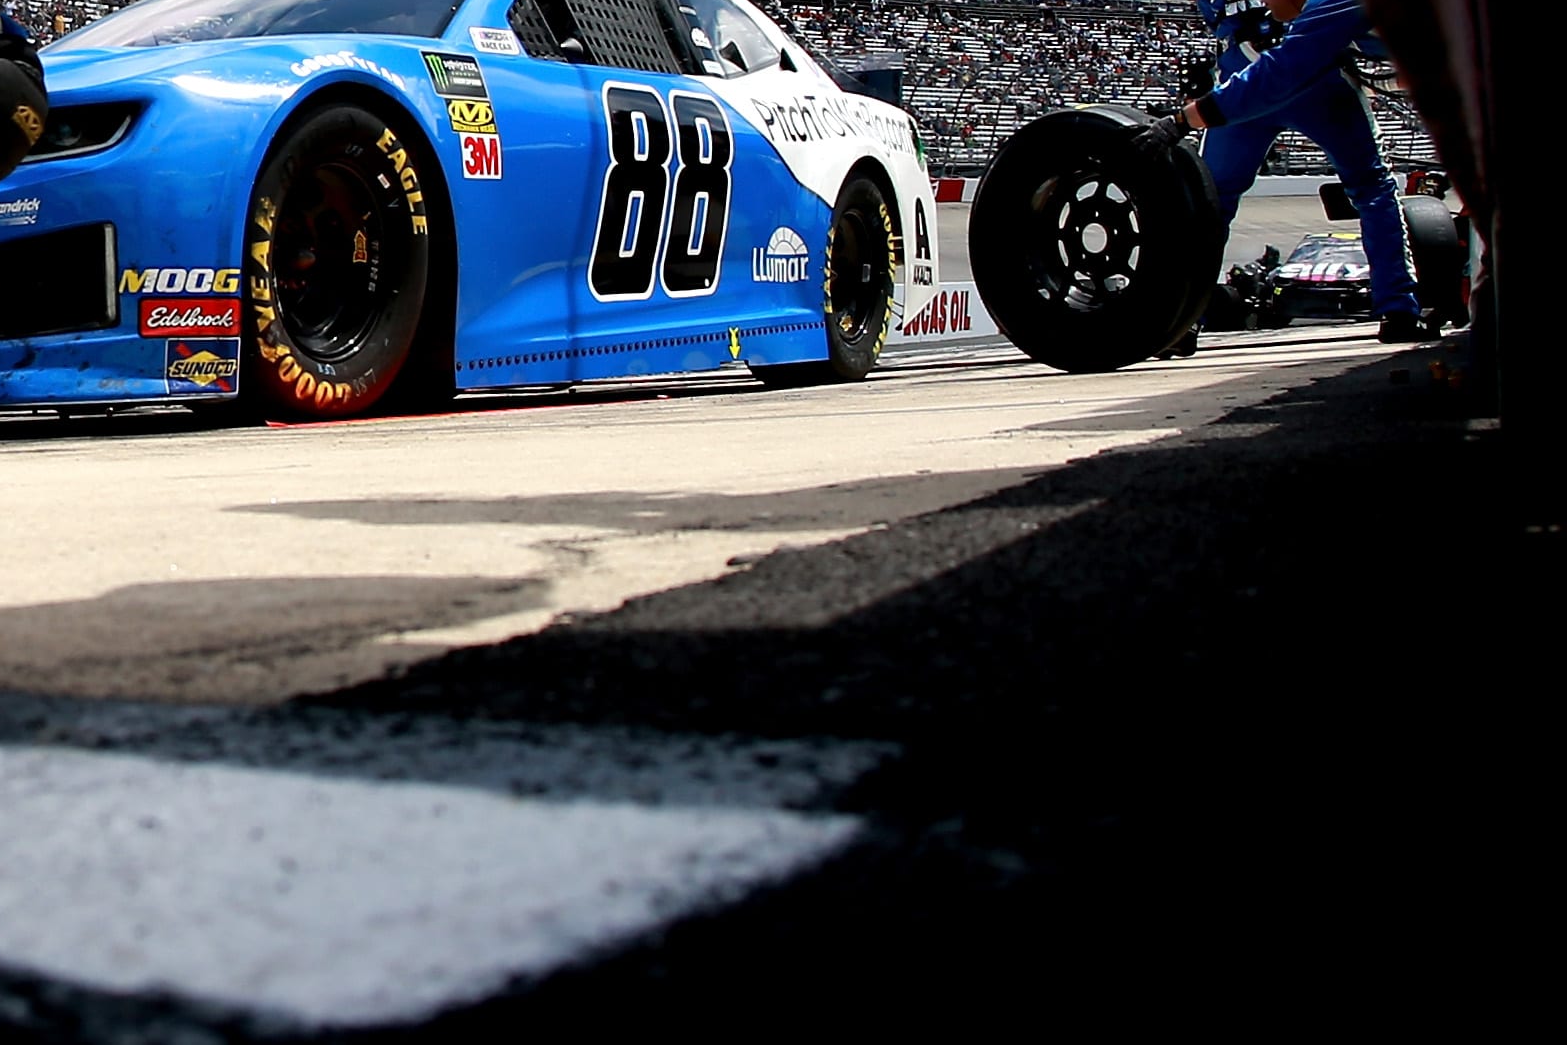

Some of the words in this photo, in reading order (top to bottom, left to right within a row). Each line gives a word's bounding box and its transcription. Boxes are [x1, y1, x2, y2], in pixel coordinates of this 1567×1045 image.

[463, 136, 500, 177] 3M
[376, 127, 428, 236] EAGLE
[587, 80, 734, 302] 88
[118, 268, 241, 294] MOOG
[752, 247, 810, 283] LLumar
[146, 306, 234, 328] Edelbrock
[950, 289, 971, 333] OIL
[170, 360, 235, 375] SUNOCO
